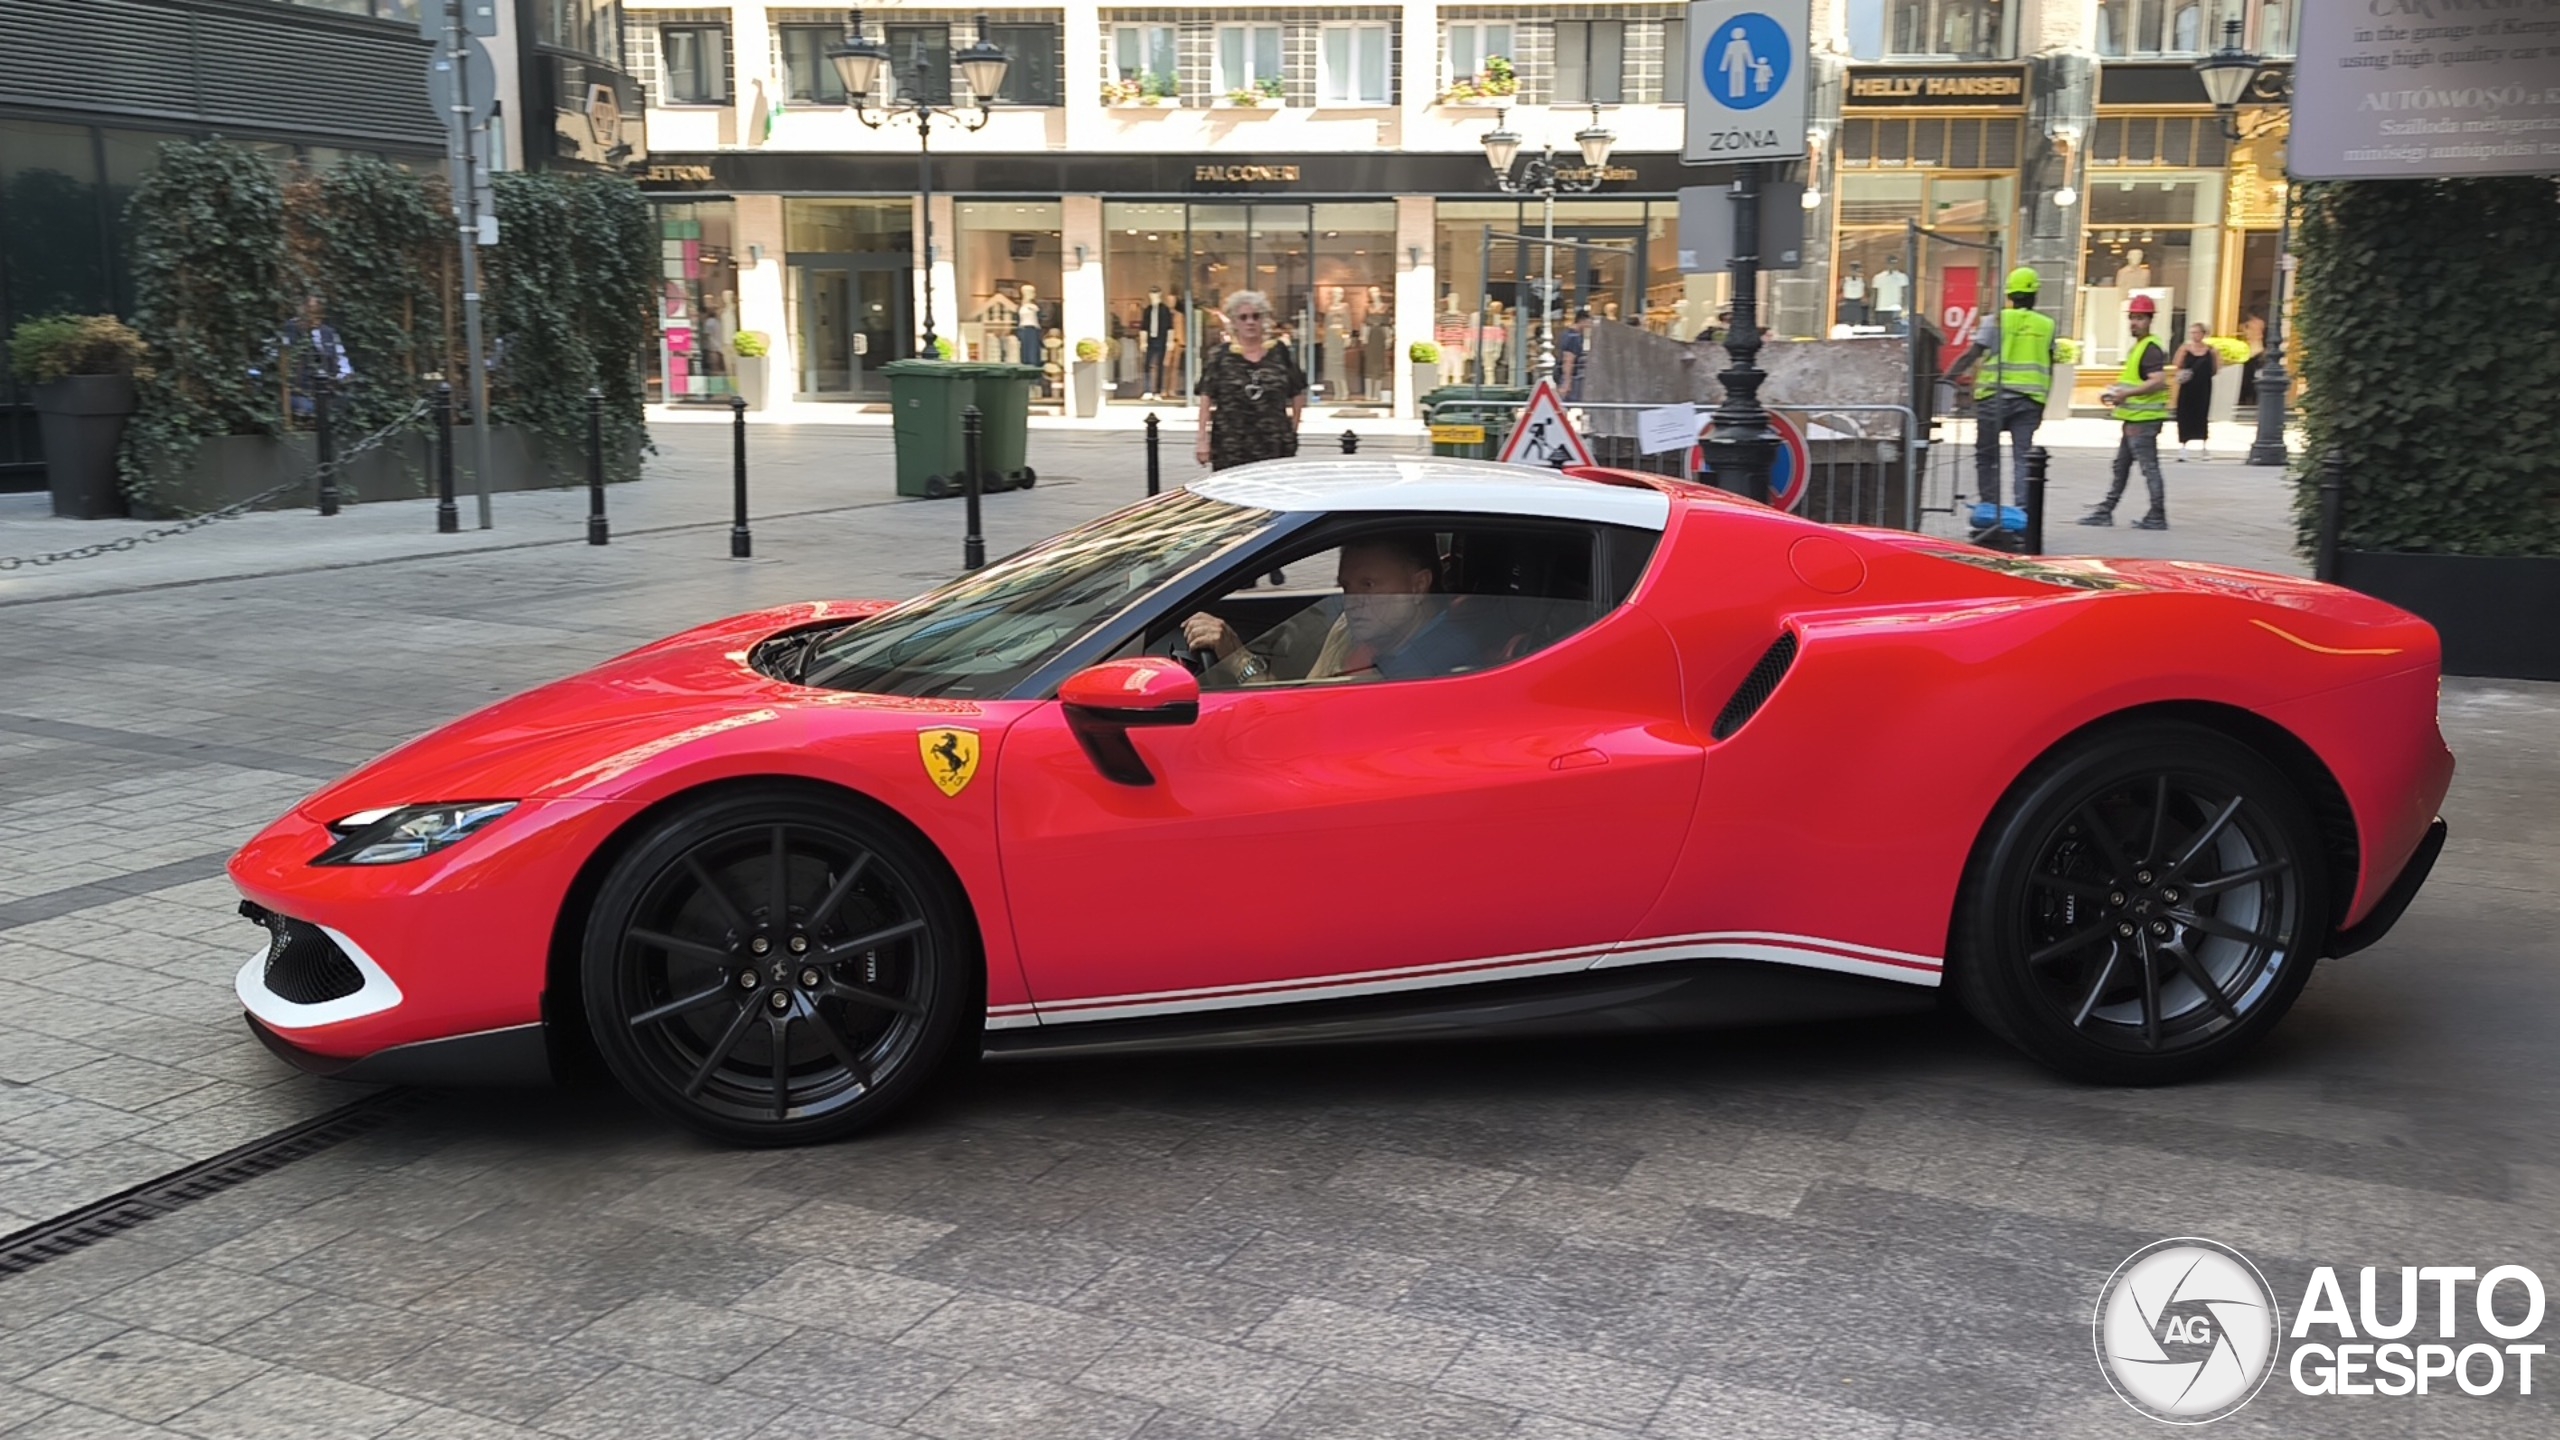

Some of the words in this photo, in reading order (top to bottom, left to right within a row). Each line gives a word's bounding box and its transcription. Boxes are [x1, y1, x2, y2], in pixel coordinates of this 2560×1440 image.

[2353, 27, 2373, 42] in
[2377, 25, 2409, 41] the
[2411, 24, 2474, 43] garage
[2502, 17, 2560, 37] Kemp
[2339, 52, 2390, 70] using
[2392, 48, 2435, 68] high
[2438, 45, 2508, 68] quality
[2510, 47, 2544, 60] car
[1852, 77, 1922, 97] HELLY
[1925, 76, 2021, 96] HANSEN
[2378, 117, 2460, 136] Szálloda
[1709, 126, 1781, 151] ZÓNA
[1195, 165, 1300, 181] FALCONERI
